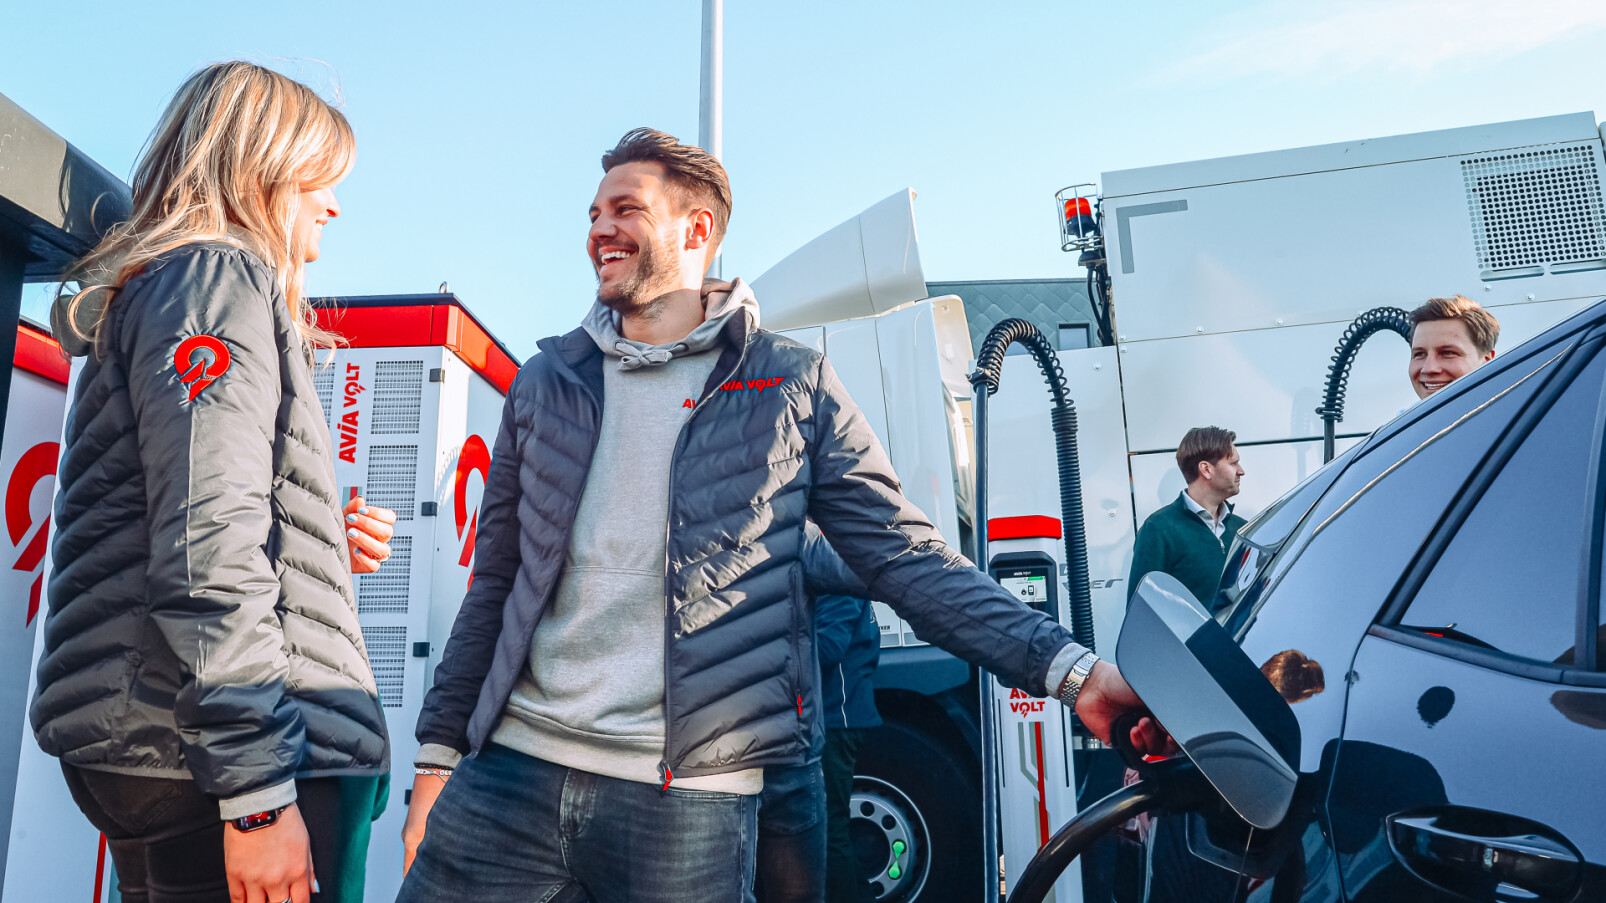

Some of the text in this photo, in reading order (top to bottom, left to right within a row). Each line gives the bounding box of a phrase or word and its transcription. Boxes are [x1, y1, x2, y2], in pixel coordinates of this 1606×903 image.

[720, 377, 785, 393] VIA VOLT
[337, 362, 367, 464] AVIA VOLT
[1009, 701, 1046, 719] VOLT
